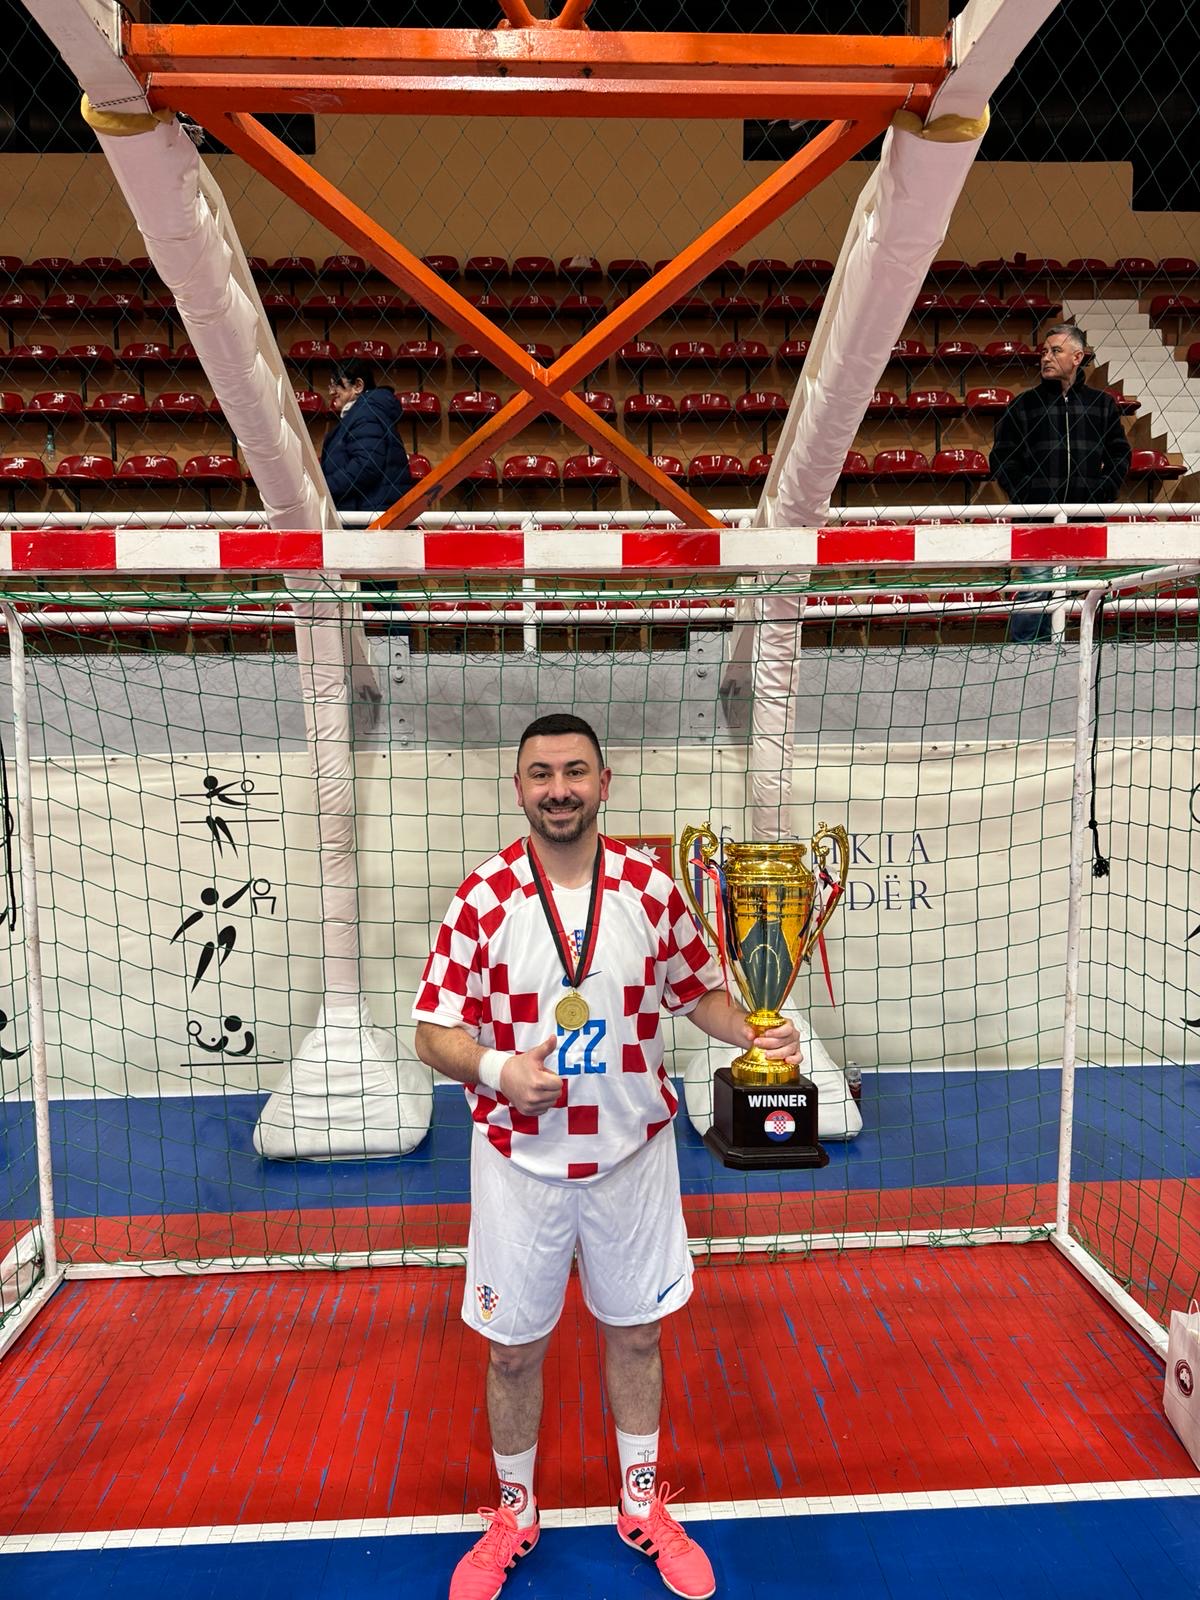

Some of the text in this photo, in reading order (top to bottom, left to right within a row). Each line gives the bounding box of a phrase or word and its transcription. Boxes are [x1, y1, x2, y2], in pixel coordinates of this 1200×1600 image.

[377, 295, 386, 305] 23
[481, 295, 489, 305] 21
[530, 295, 539, 304] 20
[579, 295, 588, 304] 19
[781, 295, 790, 305] 15
[86, 345, 96, 355] 28
[144, 344, 154, 354] 27
[311, 341, 321, 351] 24
[364, 341, 374, 351] 23
[417, 341, 427, 352] 22
[636, 342, 646, 353] 18
[689, 342, 698, 352] 17
[797, 341, 806, 352] 15
[953, 342, 962, 352] 12
[295, 392, 305, 403] 24
[410, 393, 421, 404] 22
[472, 392, 482, 403] 21
[585, 392, 595, 403] 19
[646, 394, 656, 405] 18
[702, 393, 712, 404] 17
[756, 393, 766, 404] 16
[872, 392, 881, 403] 14
[927, 392, 938, 404] 13
[986, 389, 997, 401] 12
[526, 455, 538, 468] 20
[711, 455, 721, 468] 17
[896, 450, 906, 462] 14
[954, 450, 966, 462] 13
[145, 456, 157, 468] 26
[208, 456, 221, 468] 25
[587, 456, 597, 468] 19
[653, 456, 664, 468] 18
[963, 592, 974, 603] 14
[556, 1019, 607, 1076] 22
[747, 1094, 808, 1108] WINNER
